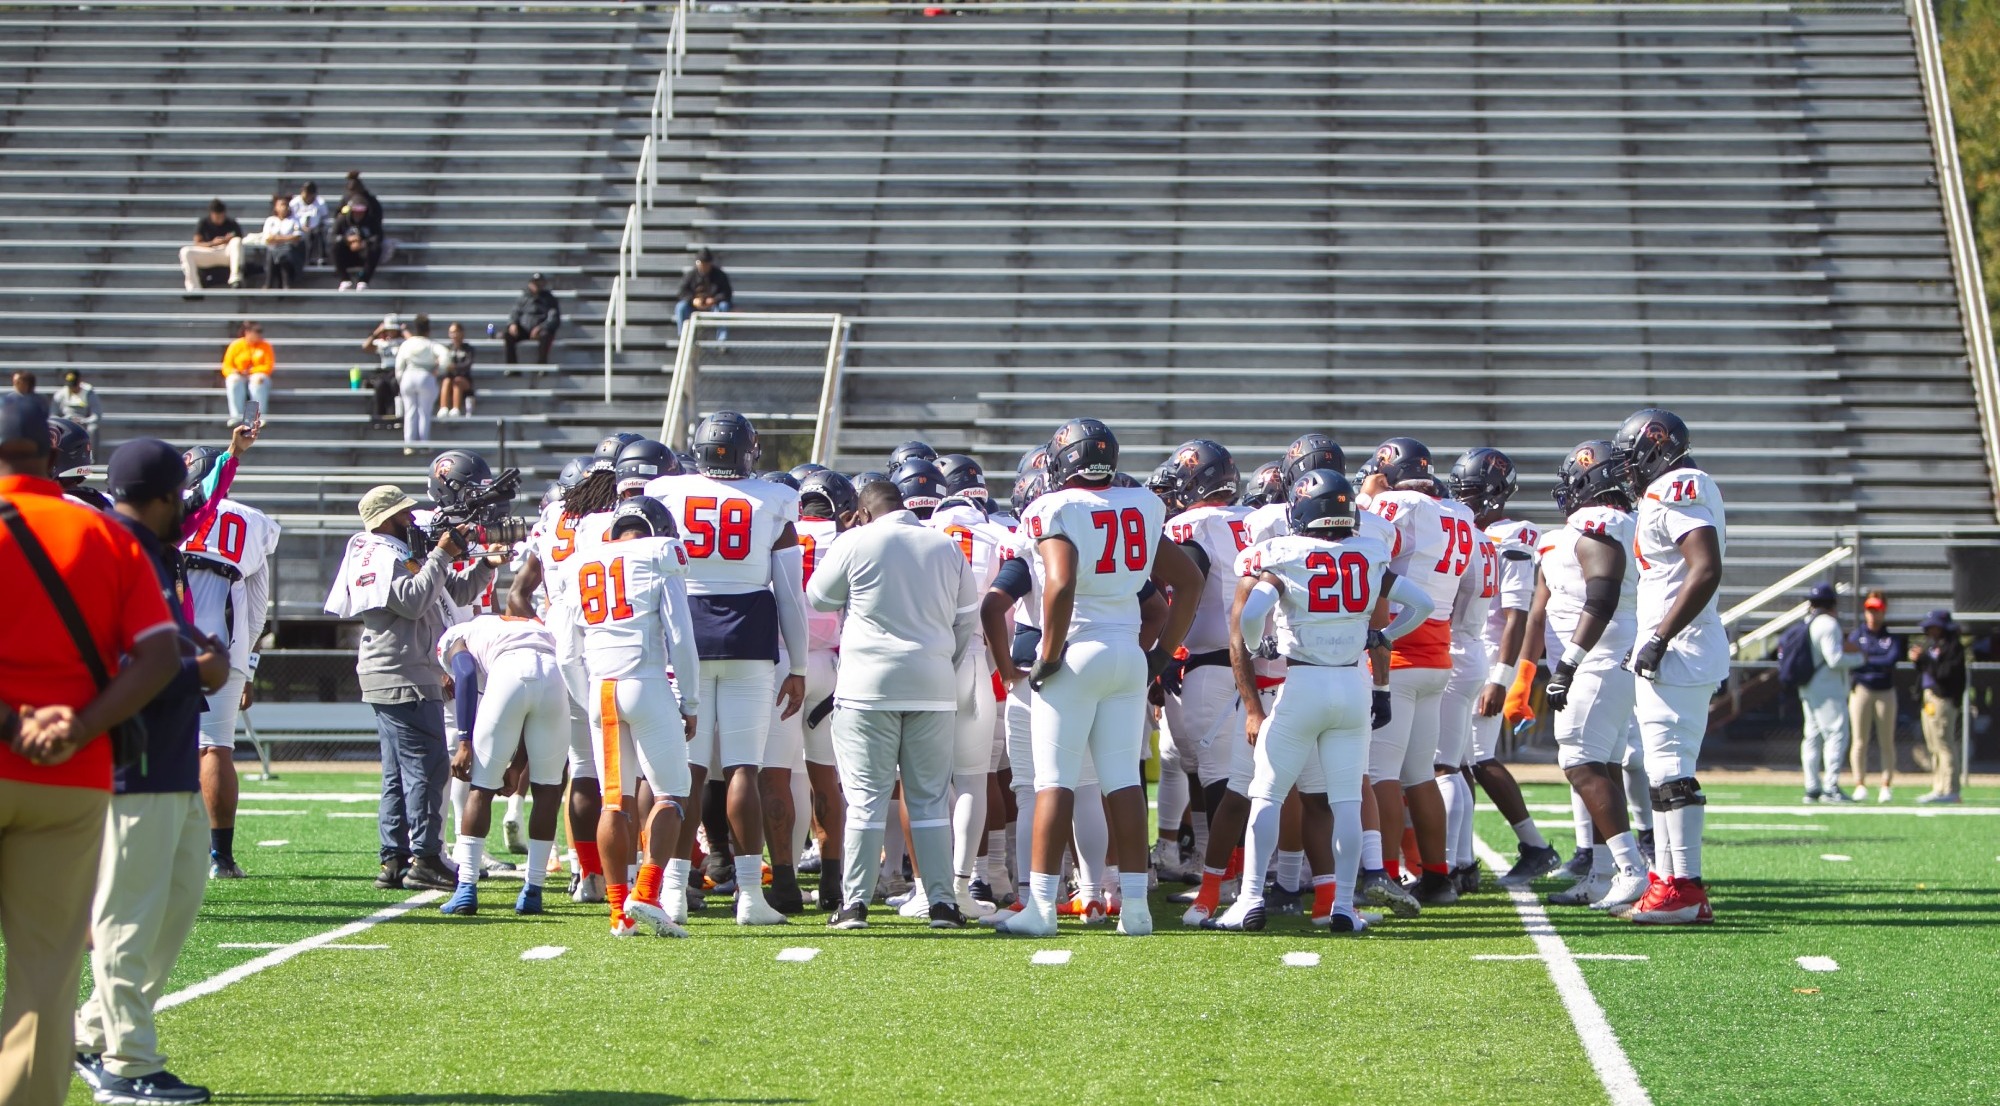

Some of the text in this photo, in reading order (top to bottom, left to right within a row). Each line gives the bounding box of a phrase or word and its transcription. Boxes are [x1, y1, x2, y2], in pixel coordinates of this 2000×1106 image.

[1378, 500, 1399, 521] 79
[1673, 480, 1696, 501] 74
[684, 496, 752, 561] 58
[1091, 507, 1147, 574] 78
[1172, 523, 1193, 545] 50
[1434, 515, 1473, 577] 79
[579, 556, 634, 625] 81
[1306, 551, 1370, 614] 20
